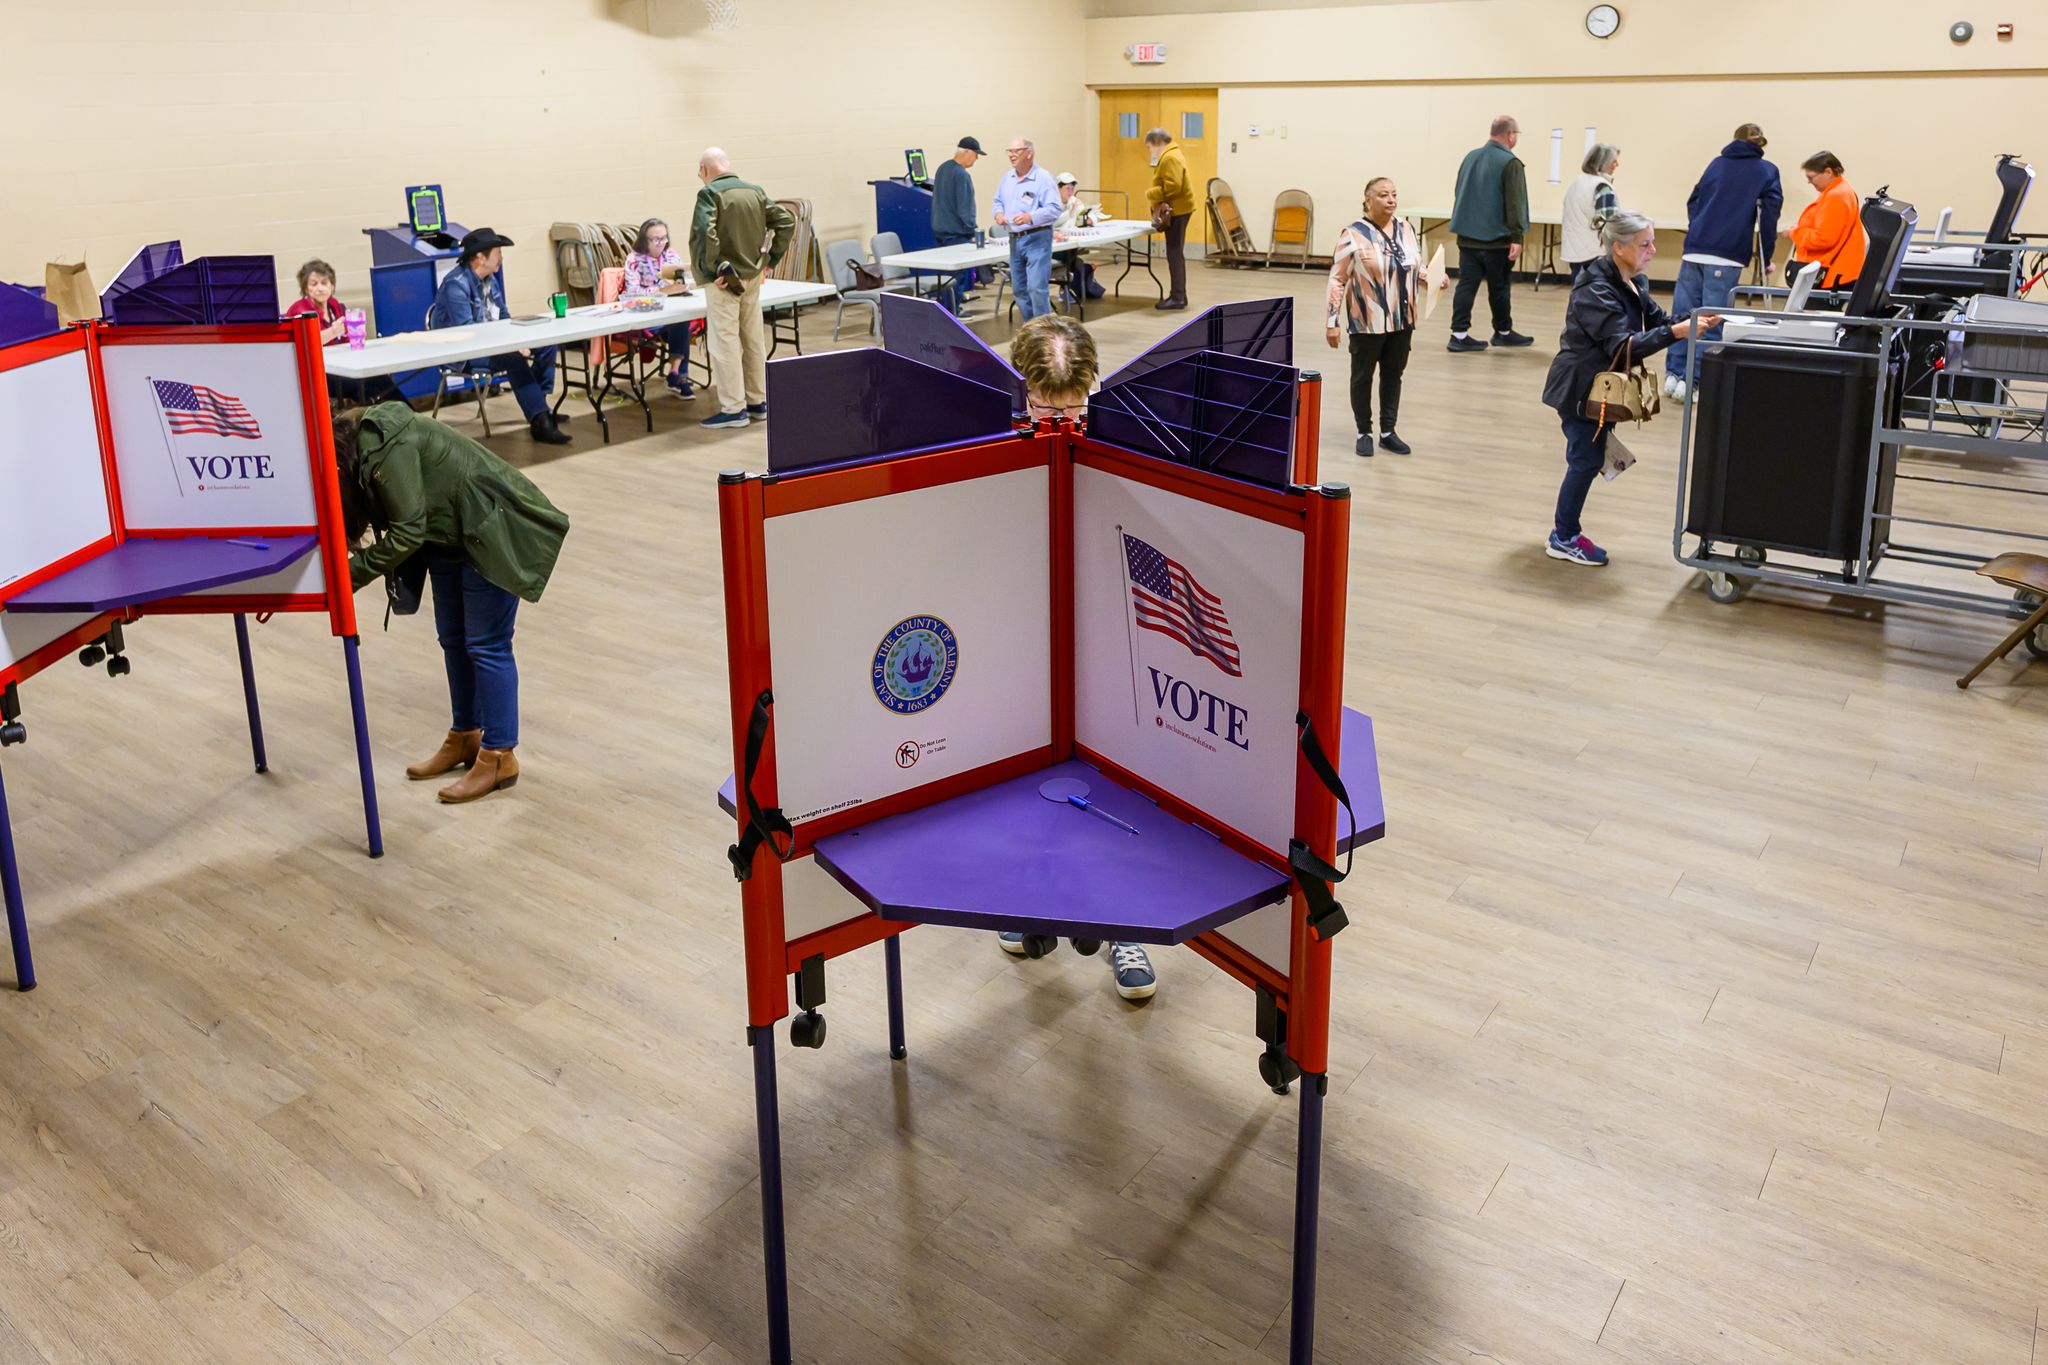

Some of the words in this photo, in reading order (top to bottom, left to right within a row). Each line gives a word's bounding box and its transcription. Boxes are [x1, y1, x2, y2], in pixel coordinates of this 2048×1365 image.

[1139, 46, 1154, 60] EXIT
[186, 455, 274, 480] VOTE
[894, 618, 941, 637] COUNTY
[940, 628, 954, 642] OF
[878, 634, 896, 658] THE
[873, 662, 884, 678] OF
[939, 646, 957, 692] ALBANY
[876, 680, 897, 707] SEAL
[907, 698, 928, 711] 1683
[1147, 666, 1249, 751] VOTE
[801, 808, 822, 819] weight
[831, 803, 846, 811] shelf
[846, 799, 862, 807] 25lbs
